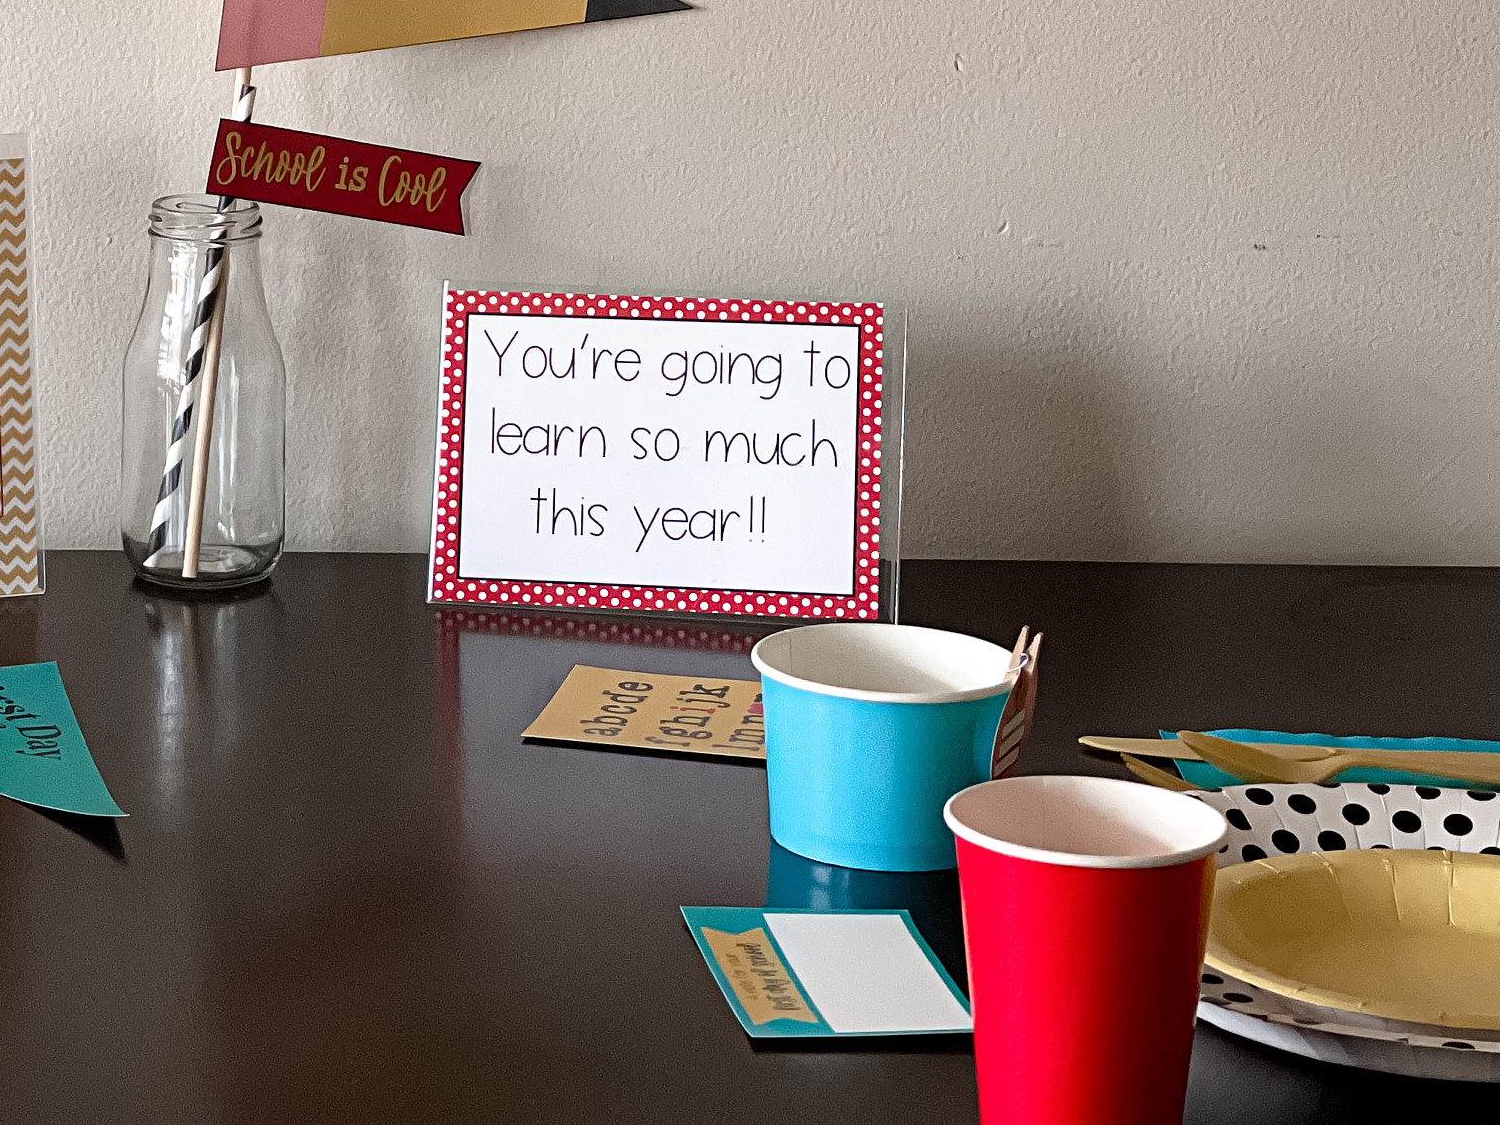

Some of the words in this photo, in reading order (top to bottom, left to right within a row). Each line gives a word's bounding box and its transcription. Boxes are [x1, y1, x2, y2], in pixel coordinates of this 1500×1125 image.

[216, 131, 327, 192] School
[334, 156, 369, 192] is
[378, 154, 447, 213] Cool
[483, 329, 642, 382] You're
[661, 345, 783, 400] going
[803, 340, 851, 390] to
[491, 407, 607, 458] learn
[630, 427, 680, 462] so
[704, 418, 838, 468] much
[530, 487, 608, 538] this
[633, 495, 766, 553] year!!
[579, 680, 654, 738] abcde
[644, 683, 731, 747] fghijk
[14, 724, 62, 761] Day
